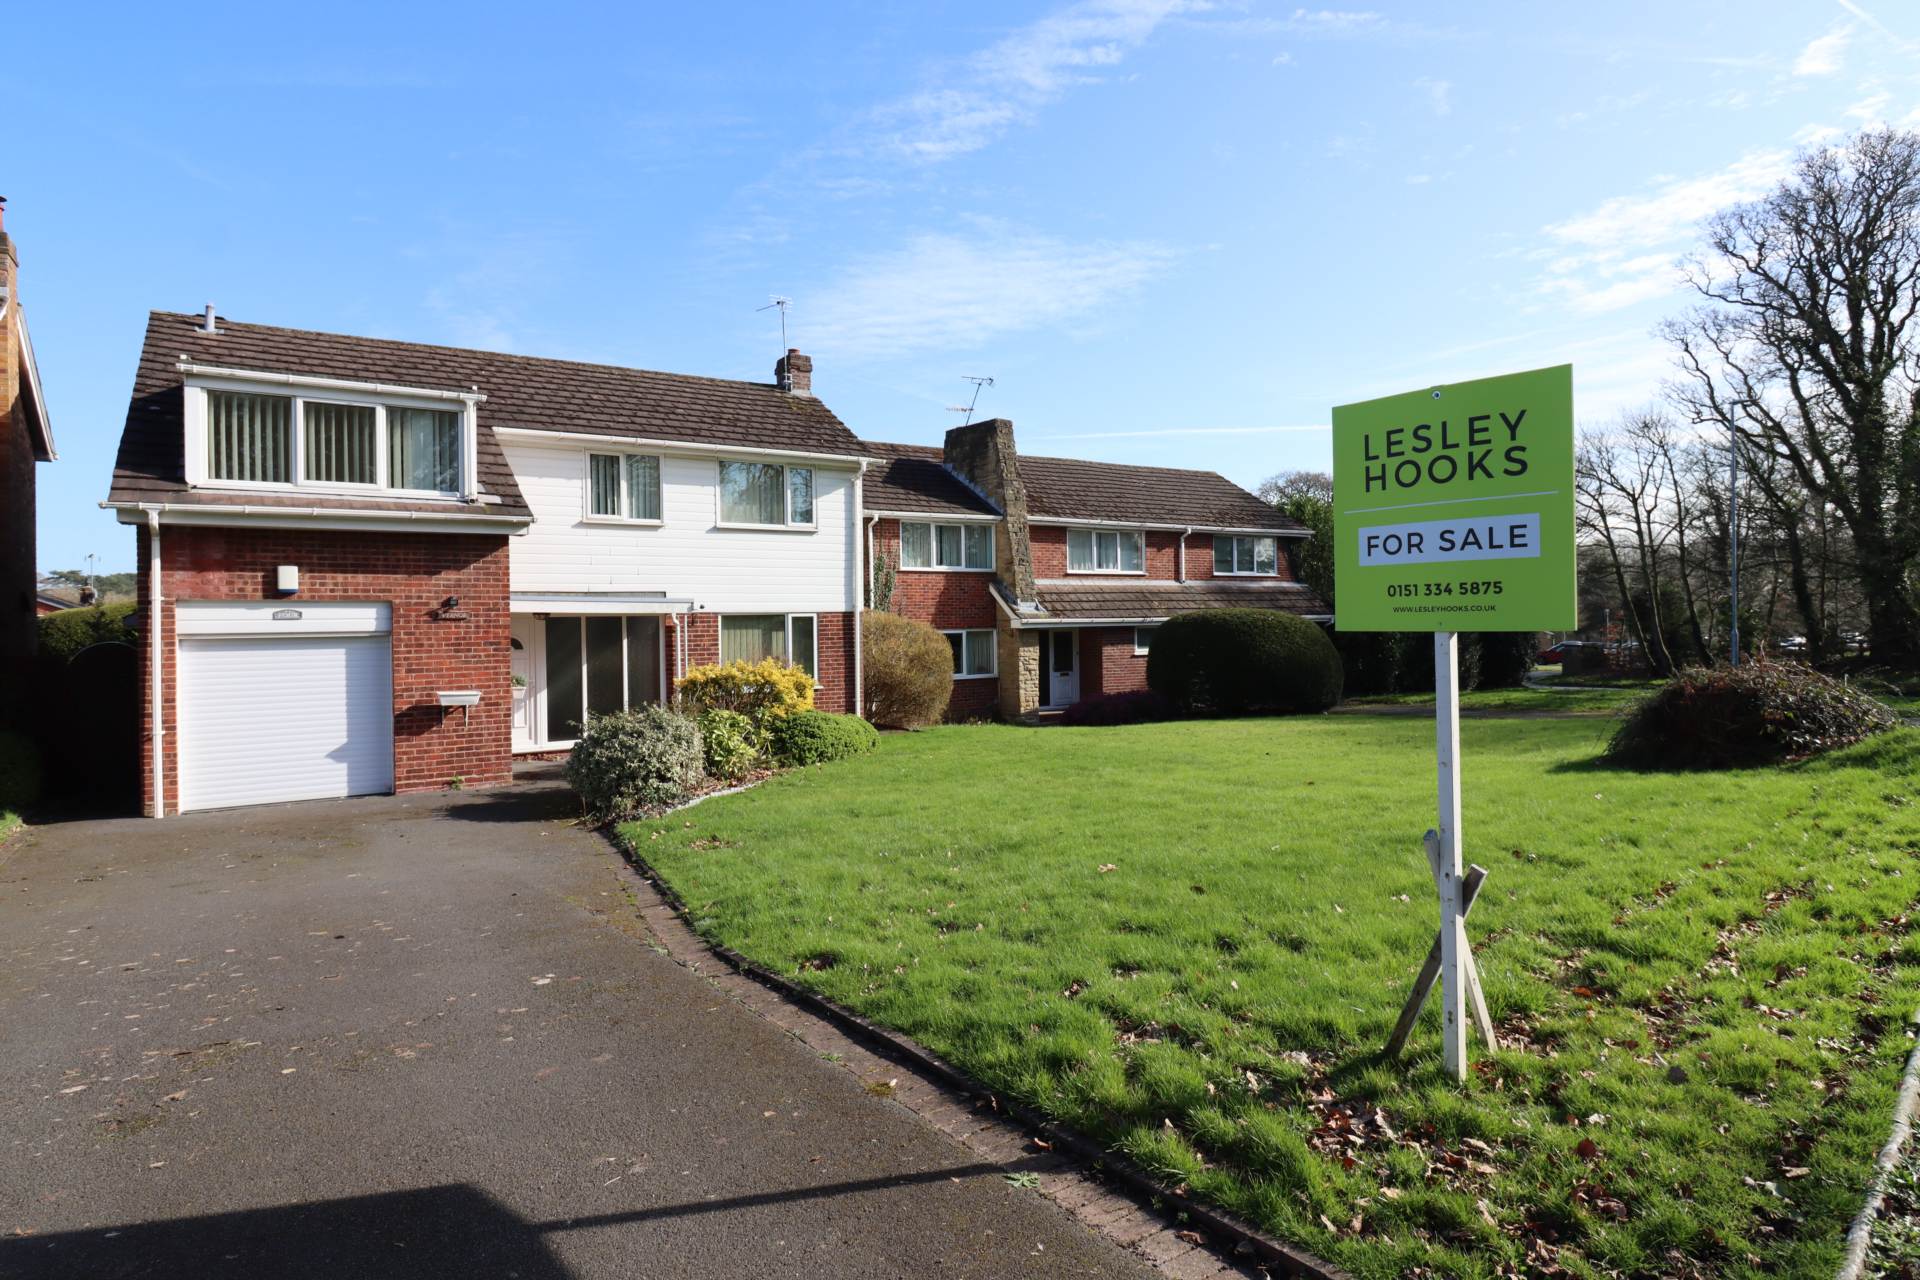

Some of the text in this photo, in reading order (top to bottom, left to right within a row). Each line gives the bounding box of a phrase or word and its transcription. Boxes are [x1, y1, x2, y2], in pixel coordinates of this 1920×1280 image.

[1364, 409, 1527, 461] LESLEY
[1364, 446, 1529, 493] HOOKS
[1367, 524, 1529, 557] FOR SALE
[1387, 580, 1504, 598] 0151 334 5875
[1393, 605, 1497, 613] WWW.LESLEYHOOKS.CO.UK
